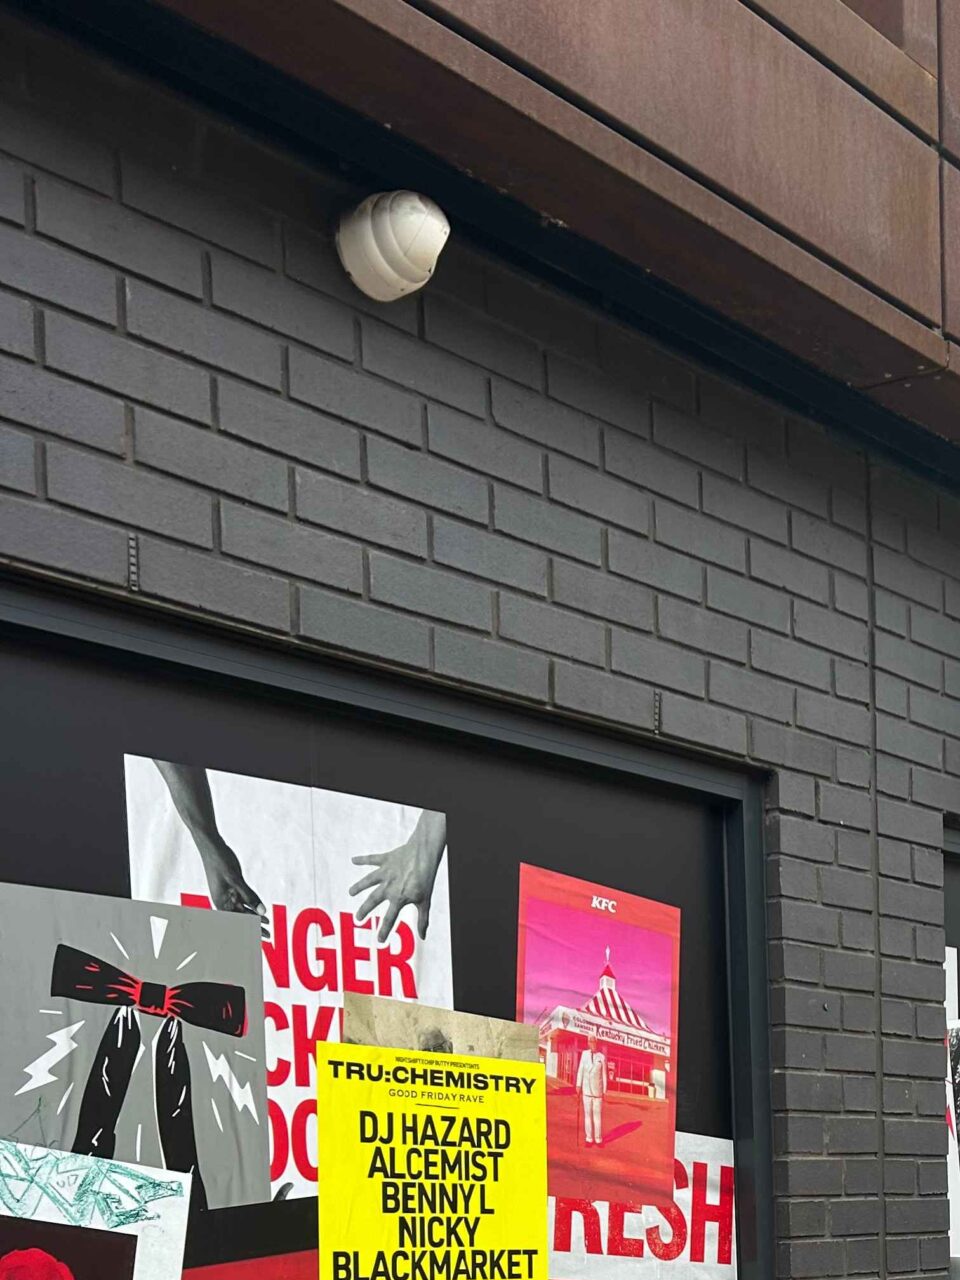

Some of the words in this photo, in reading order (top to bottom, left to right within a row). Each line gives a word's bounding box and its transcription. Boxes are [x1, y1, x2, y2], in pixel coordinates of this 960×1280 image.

[591, 896, 617, 913] KFC
[261, 904, 418, 999] NGER
[328, 1059, 536, 1094] TRU:CHEMISTRY
[389, 1088, 417, 1098] GOOD
[421, 1091, 457, 1101] FRIDAY
[459, 1093, 484, 1103] RAVE
[359, 1110, 394, 1144] DJ
[401, 1113, 511, 1149] HAZARD
[367, 1146, 504, 1182] ALCEMIST
[382, 1182, 475, 1214] BENNY
[480, 1184, 494, 1215] L
[398, 1216, 480, 1248] NICKY
